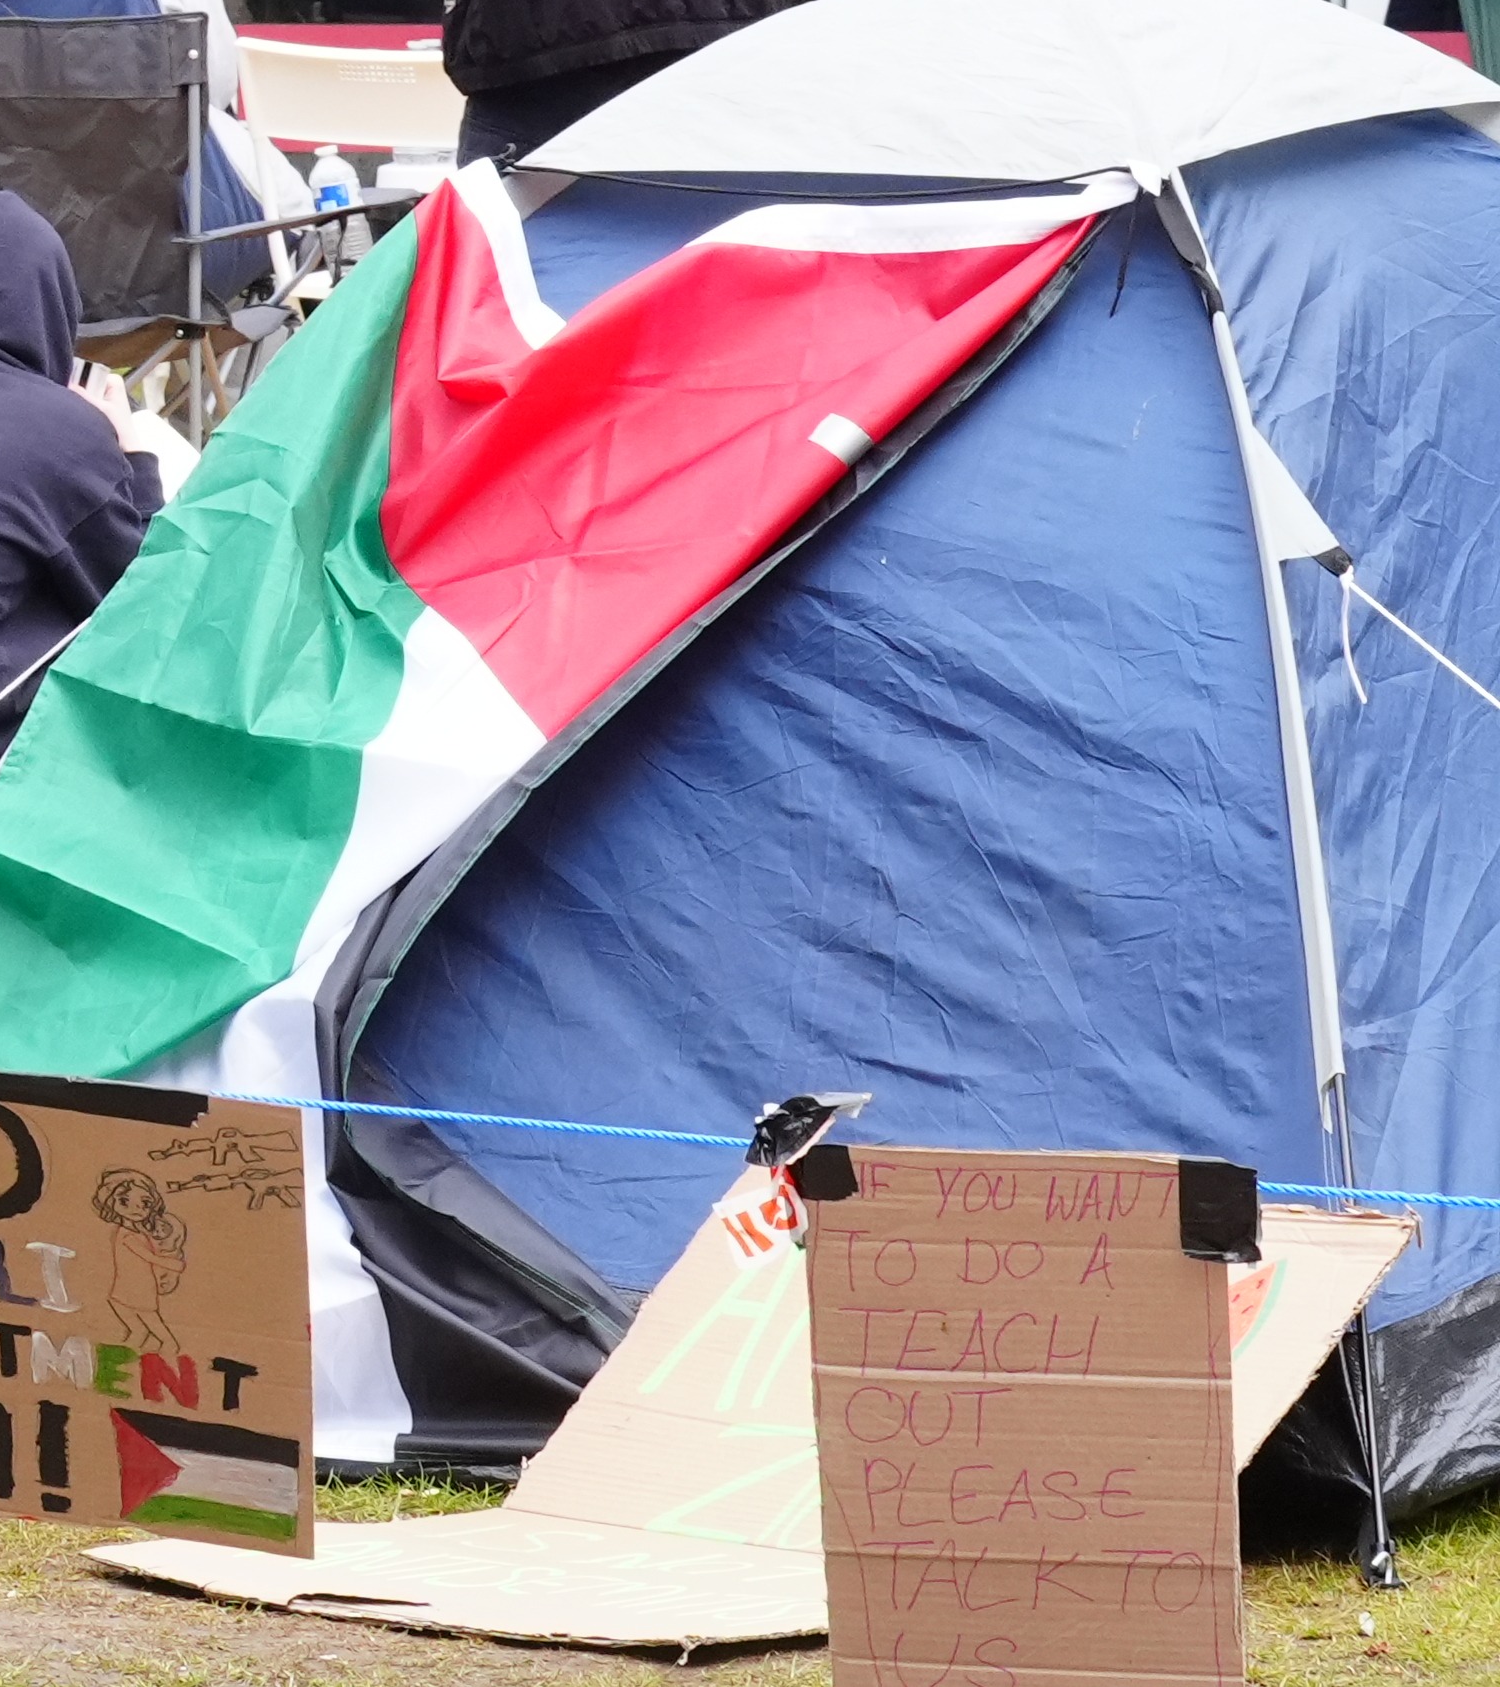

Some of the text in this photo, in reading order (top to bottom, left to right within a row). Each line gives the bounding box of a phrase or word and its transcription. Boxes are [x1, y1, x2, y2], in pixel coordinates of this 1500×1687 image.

[856, 1161, 1178, 1222] IF YOU WANT
[822, 1228, 1116, 1292] TO DO A
[837, 1307, 1100, 1379] TEACH
[844, 1385, 1013, 1448] OUT
[863, 1458, 1147, 1533] PLEASE
[863, 1539, 1204, 1614] TALK TO
